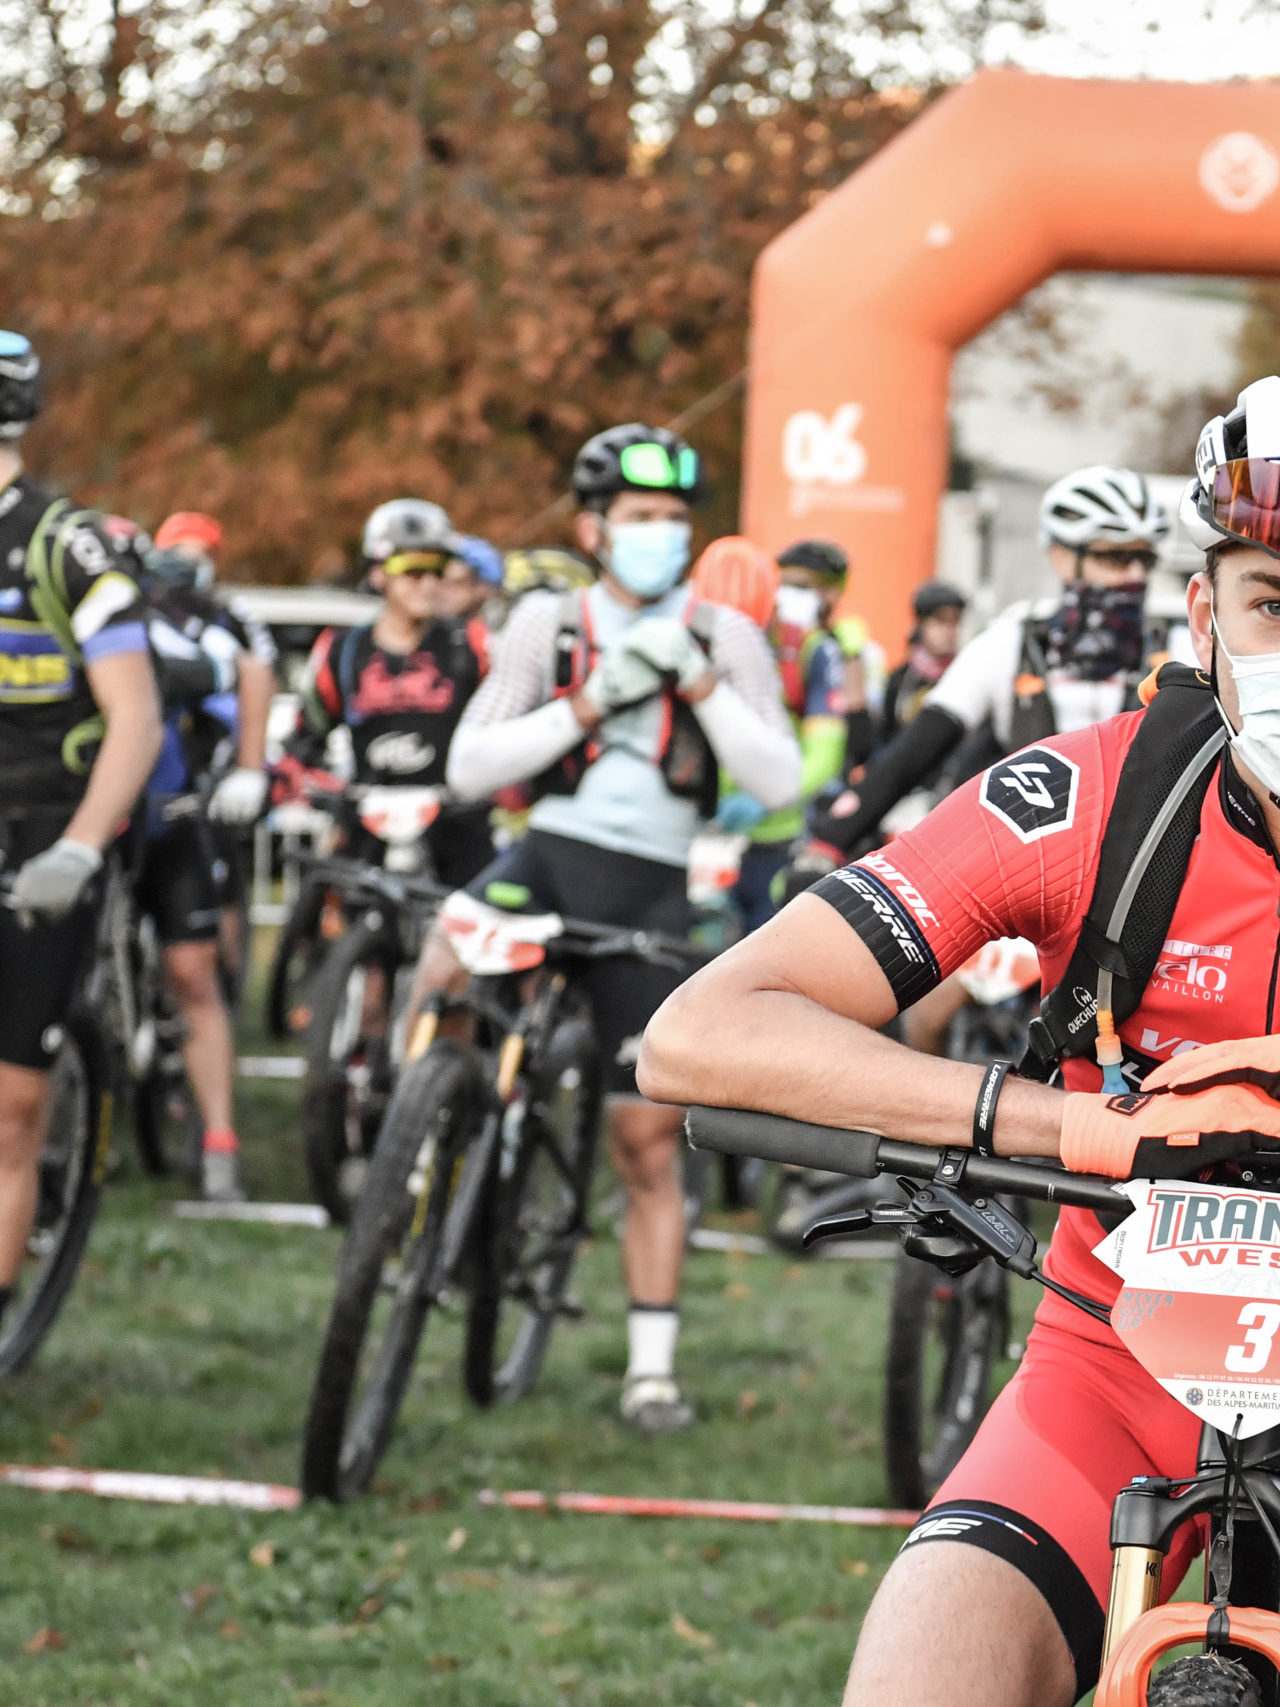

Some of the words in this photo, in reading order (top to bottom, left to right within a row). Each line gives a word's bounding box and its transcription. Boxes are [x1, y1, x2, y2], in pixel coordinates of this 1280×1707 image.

[782, 401, 867, 484] 06
[825, 869, 925, 964] PIERRE
[1152, 980, 1224, 1004] VAILLON
[979, 1063, 1001, 1132] LAPIERRE
[1207, 1398, 1221, 1407] DES
